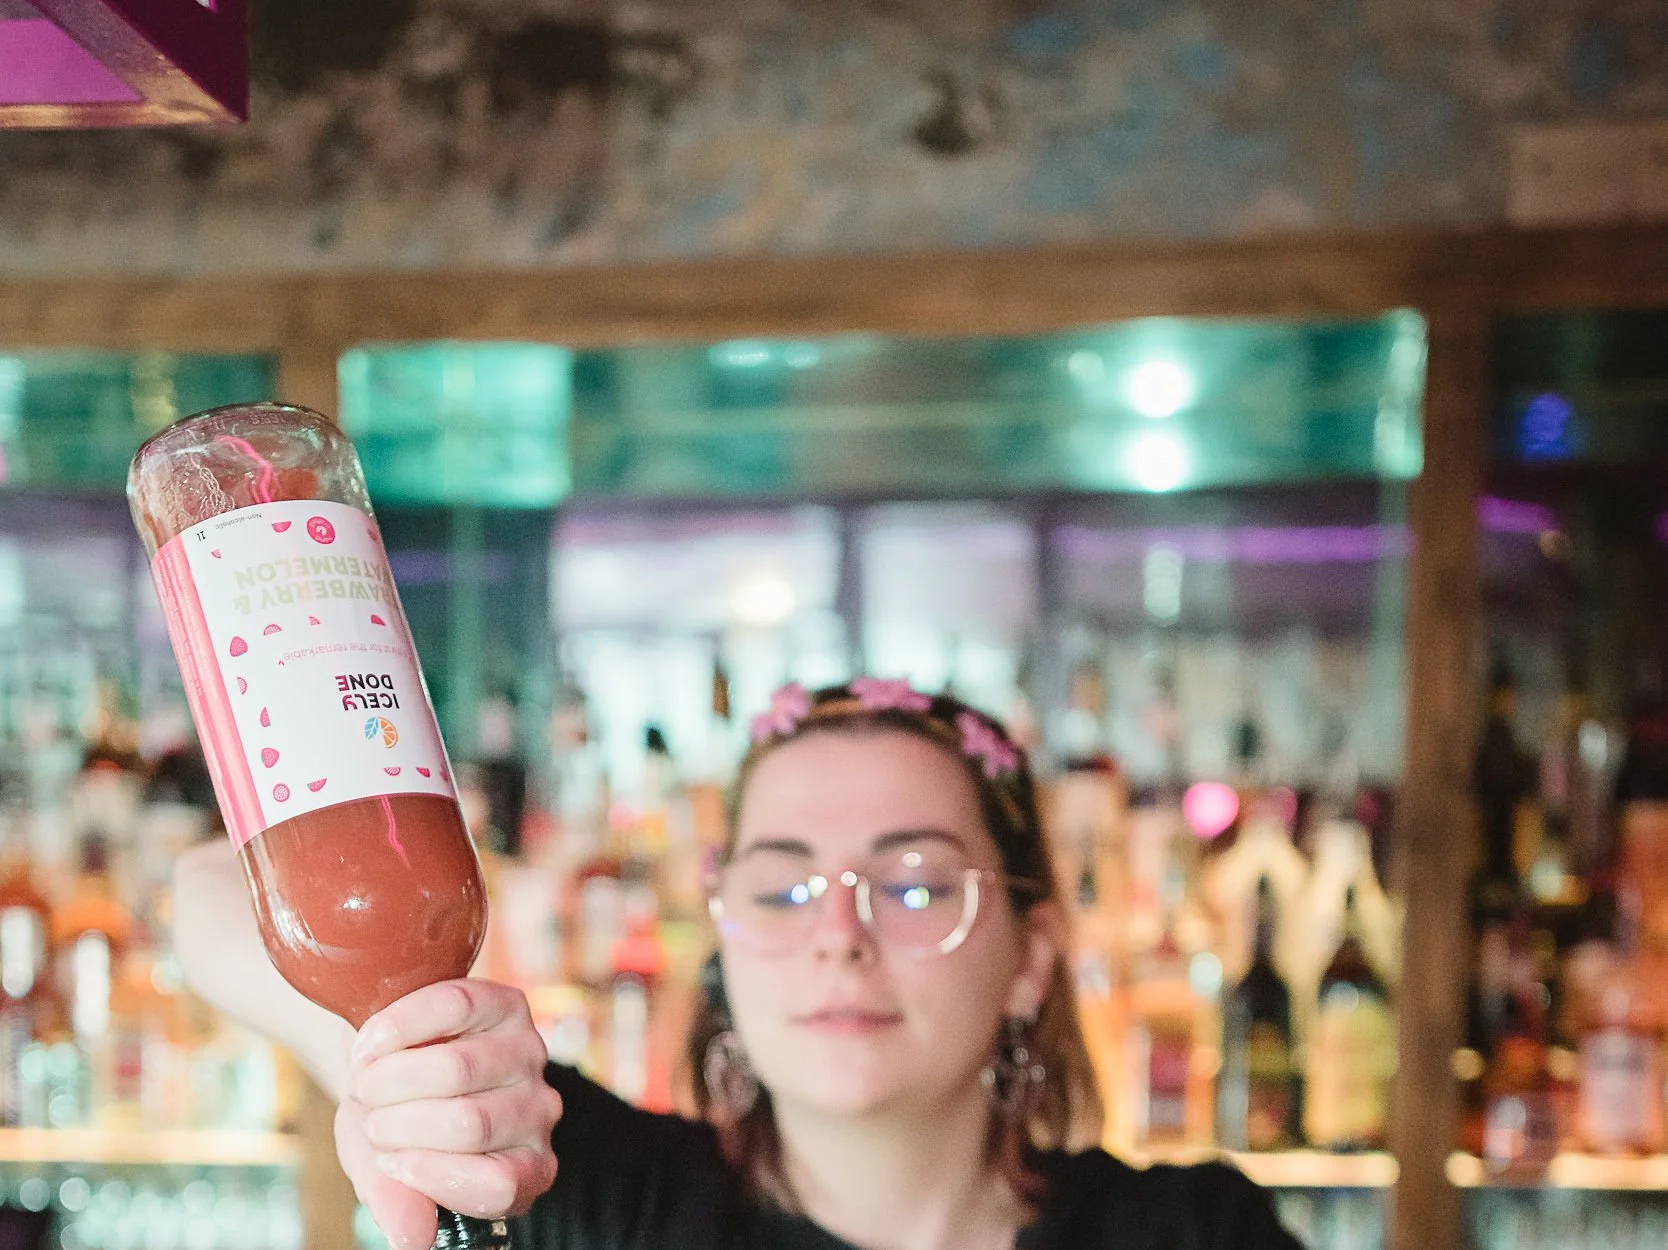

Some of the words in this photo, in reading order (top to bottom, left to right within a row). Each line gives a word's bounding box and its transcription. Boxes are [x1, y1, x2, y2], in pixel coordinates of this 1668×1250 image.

[261, 578, 394, 609] RAWBERRY
[233, 595, 252, 615] &
[350, 643, 367, 653] the
[335, 673, 394, 692] DONE
[341, 692, 400, 711] ICELY
